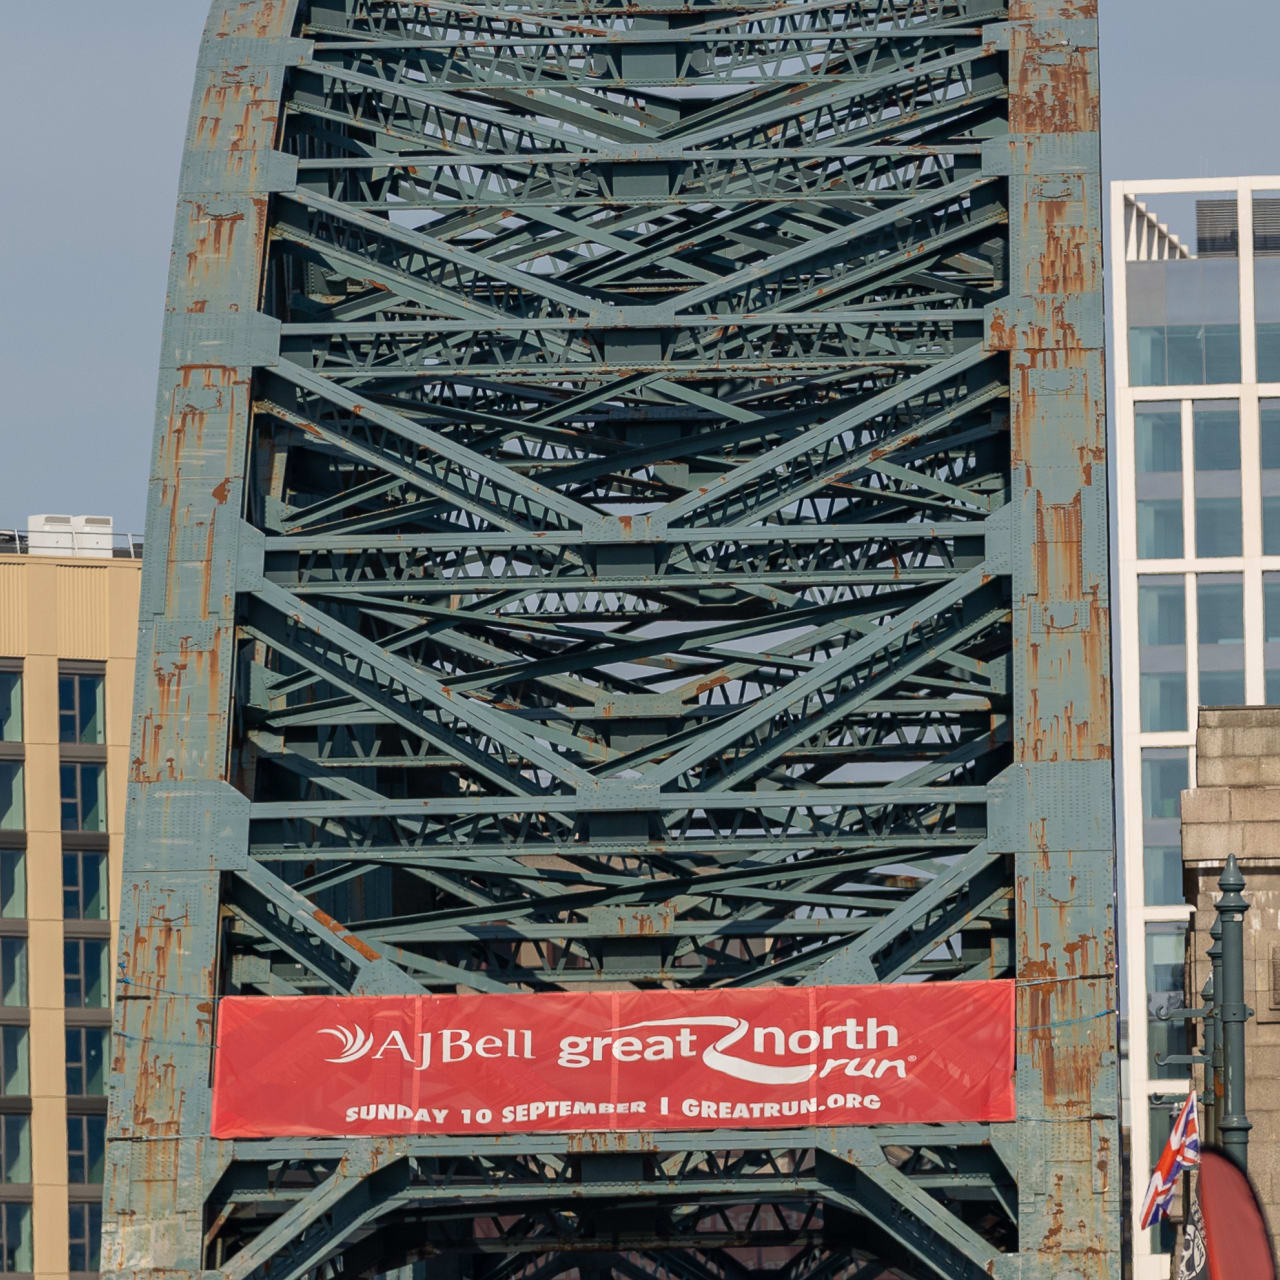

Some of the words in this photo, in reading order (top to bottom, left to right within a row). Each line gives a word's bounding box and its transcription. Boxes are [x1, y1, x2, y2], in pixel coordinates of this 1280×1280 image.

[557, 1028, 697, 1068] great
[754, 1018, 899, 1056] north
[819, 1057, 907, 1079] run
[345, 1103, 449, 1124] SUNDAY
[461, 1108, 493, 1124] 10
[502, 1099, 647, 1123] SEPTEMBER
[682, 1093, 882, 1119] GREATRUN.ORG
